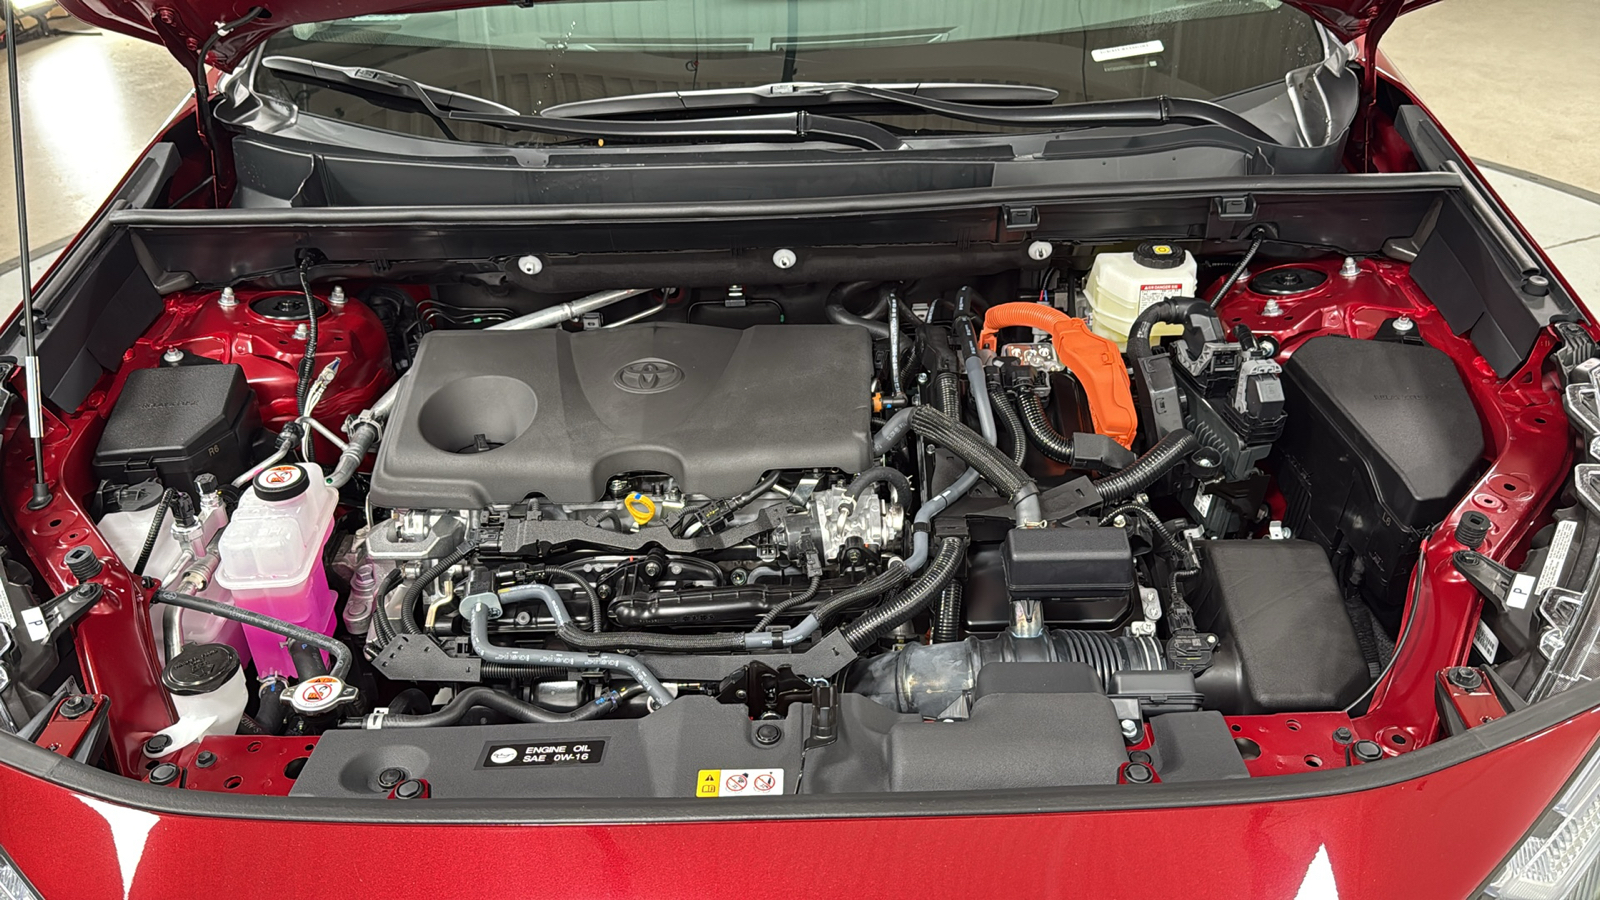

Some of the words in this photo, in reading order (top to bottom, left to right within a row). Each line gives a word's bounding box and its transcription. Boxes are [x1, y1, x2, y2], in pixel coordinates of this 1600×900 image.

[207, 444, 220, 457] R6
[1513, 587, 1528, 596] P
[525, 745, 567, 754] ENGINE
[572, 744, 591, 752] OIL
[522, 754, 547, 763] SAE
[553, 752, 589, 761] 0W-16
